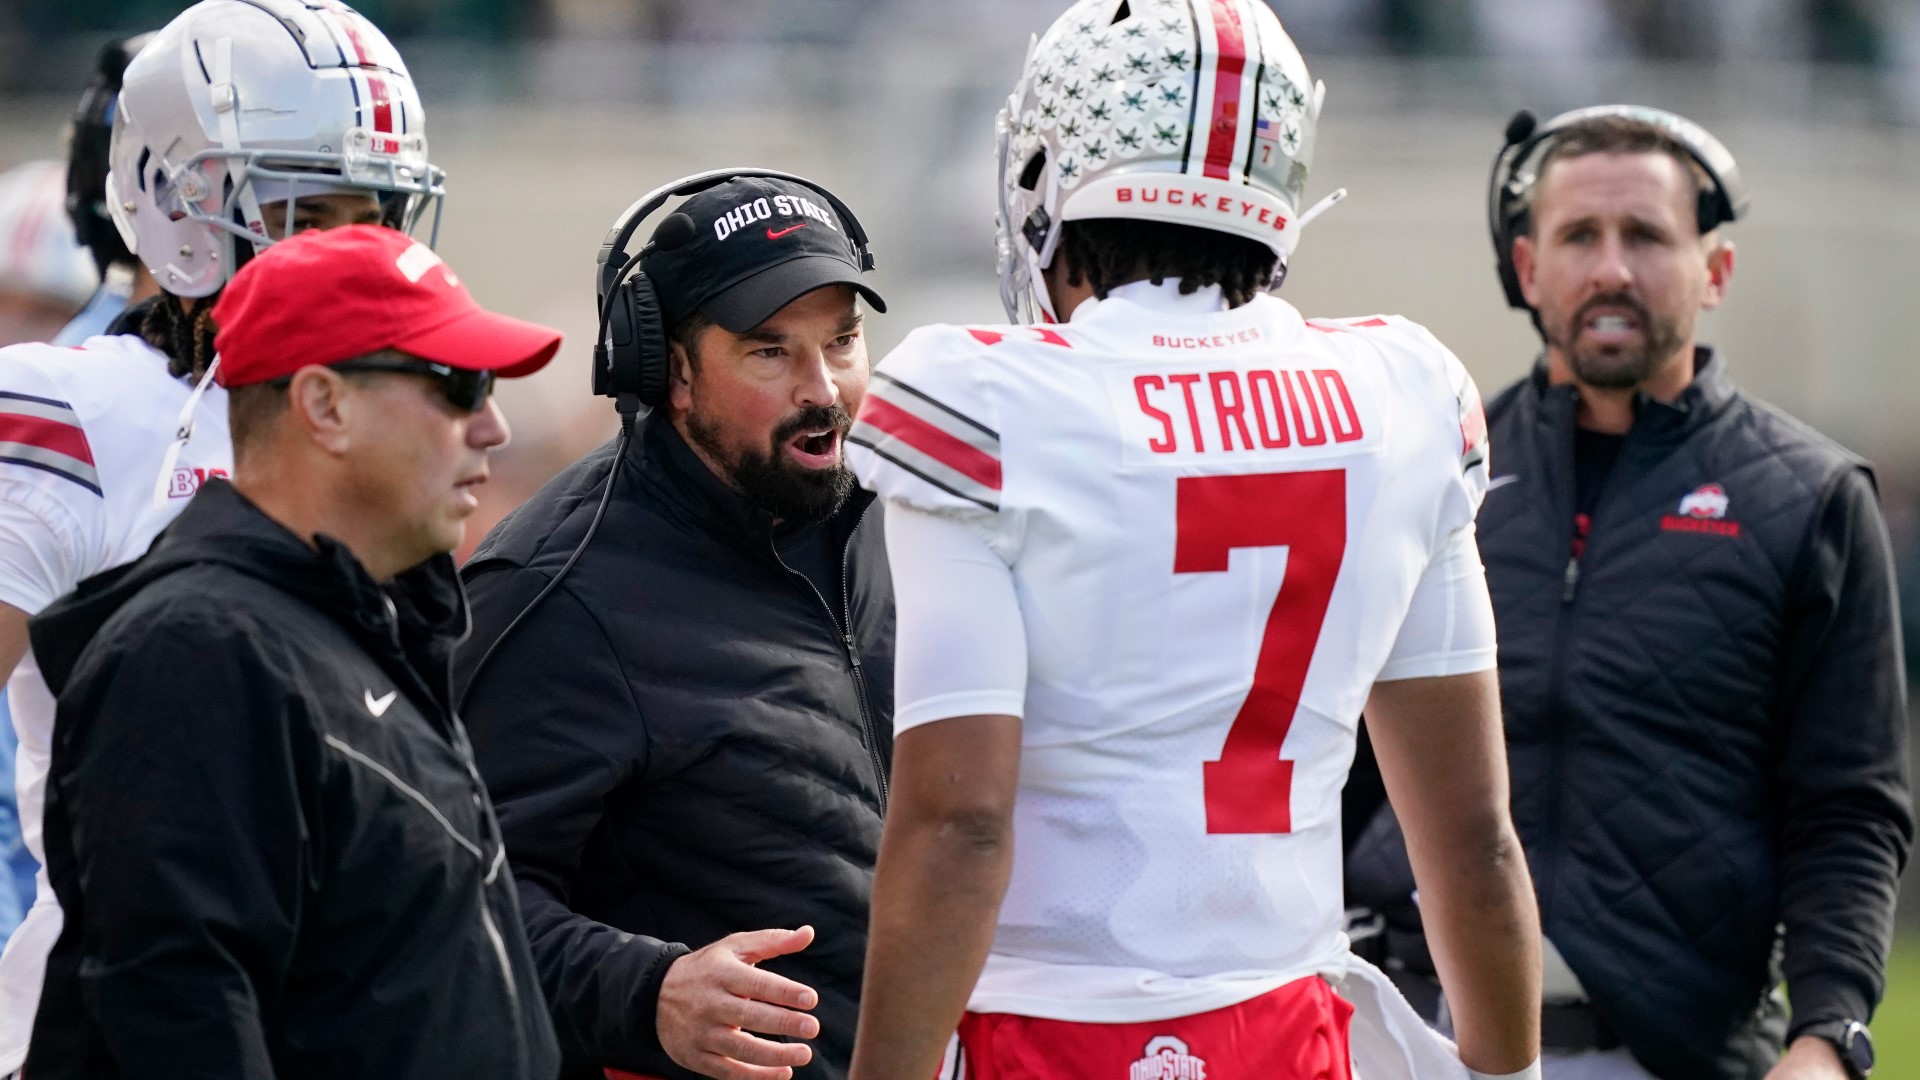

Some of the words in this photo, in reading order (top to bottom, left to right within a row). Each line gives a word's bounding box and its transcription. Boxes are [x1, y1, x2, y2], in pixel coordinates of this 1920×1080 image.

[1262, 144, 1271, 164] 7
[713, 197, 772, 241] OHIO
[773, 194, 838, 232] STATE
[1116, 188, 1287, 231] BUCKEYES
[1152, 327, 1260, 349] BUCKEYES
[1133, 369, 1364, 453] STROUD
[1173, 469, 1347, 834] 7
